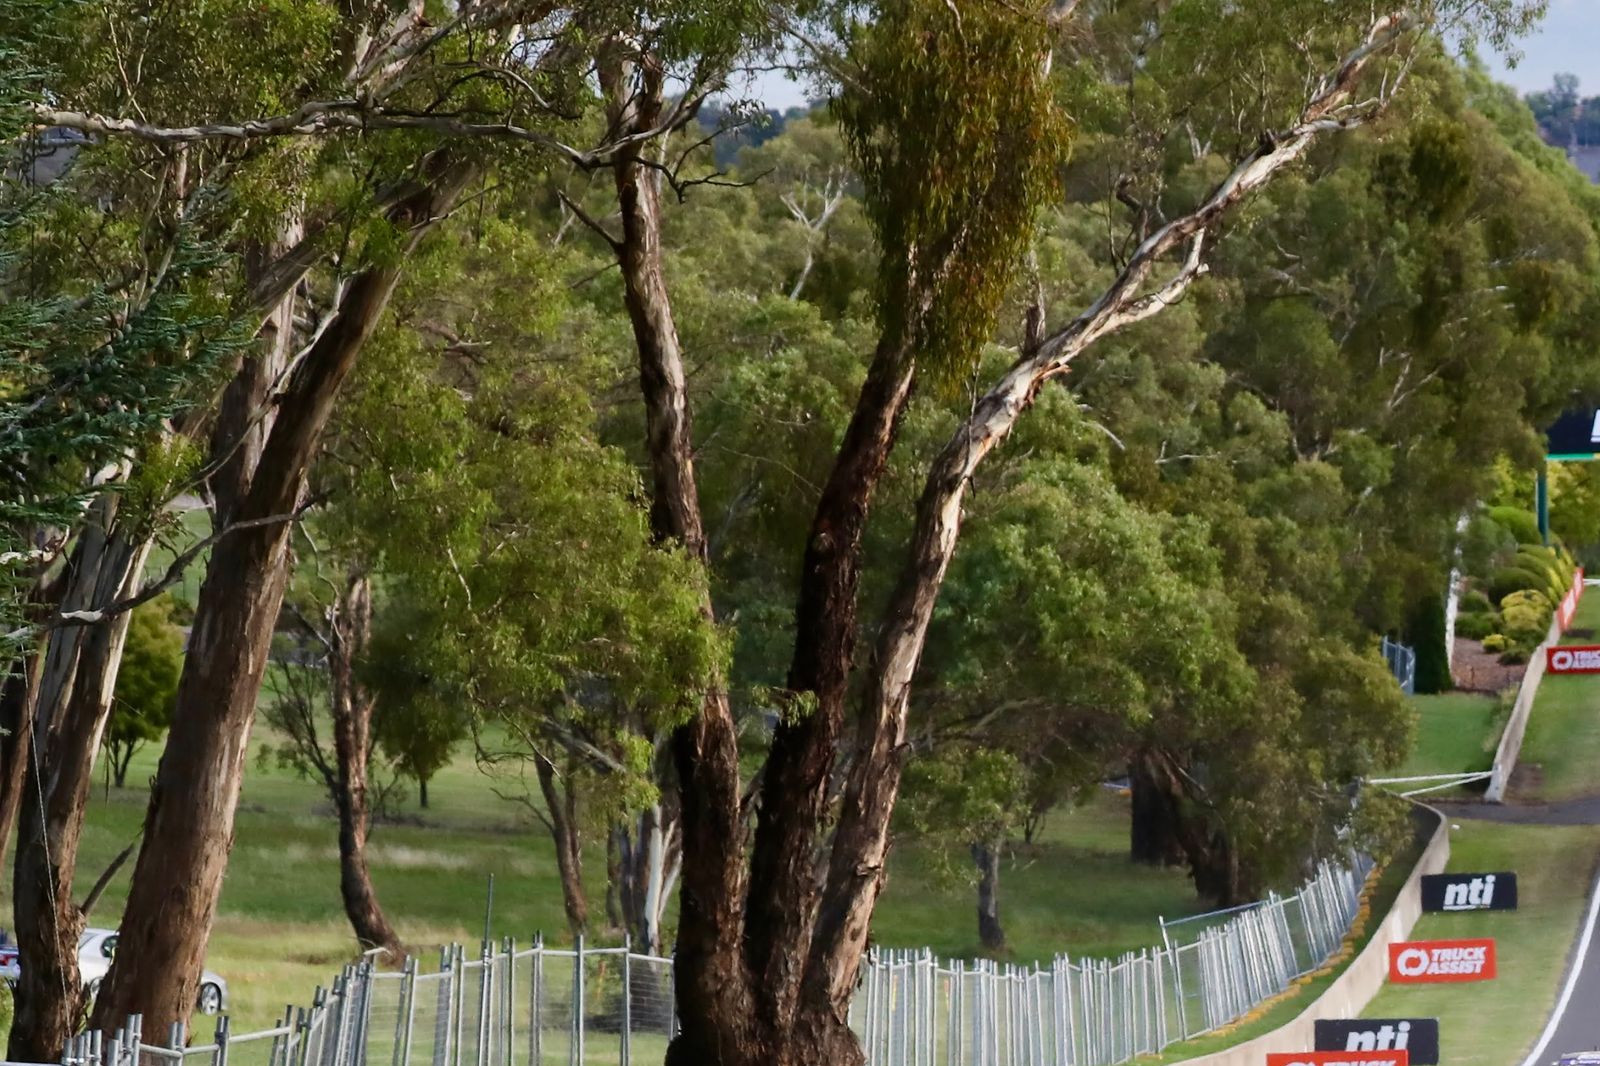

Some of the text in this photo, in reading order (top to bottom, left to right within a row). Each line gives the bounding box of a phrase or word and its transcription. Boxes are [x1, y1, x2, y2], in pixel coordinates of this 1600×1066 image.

[1444, 875, 1496, 908] nti
[1430, 946, 1488, 962] TRUCK
[1426, 960, 1486, 975] ASSIST
